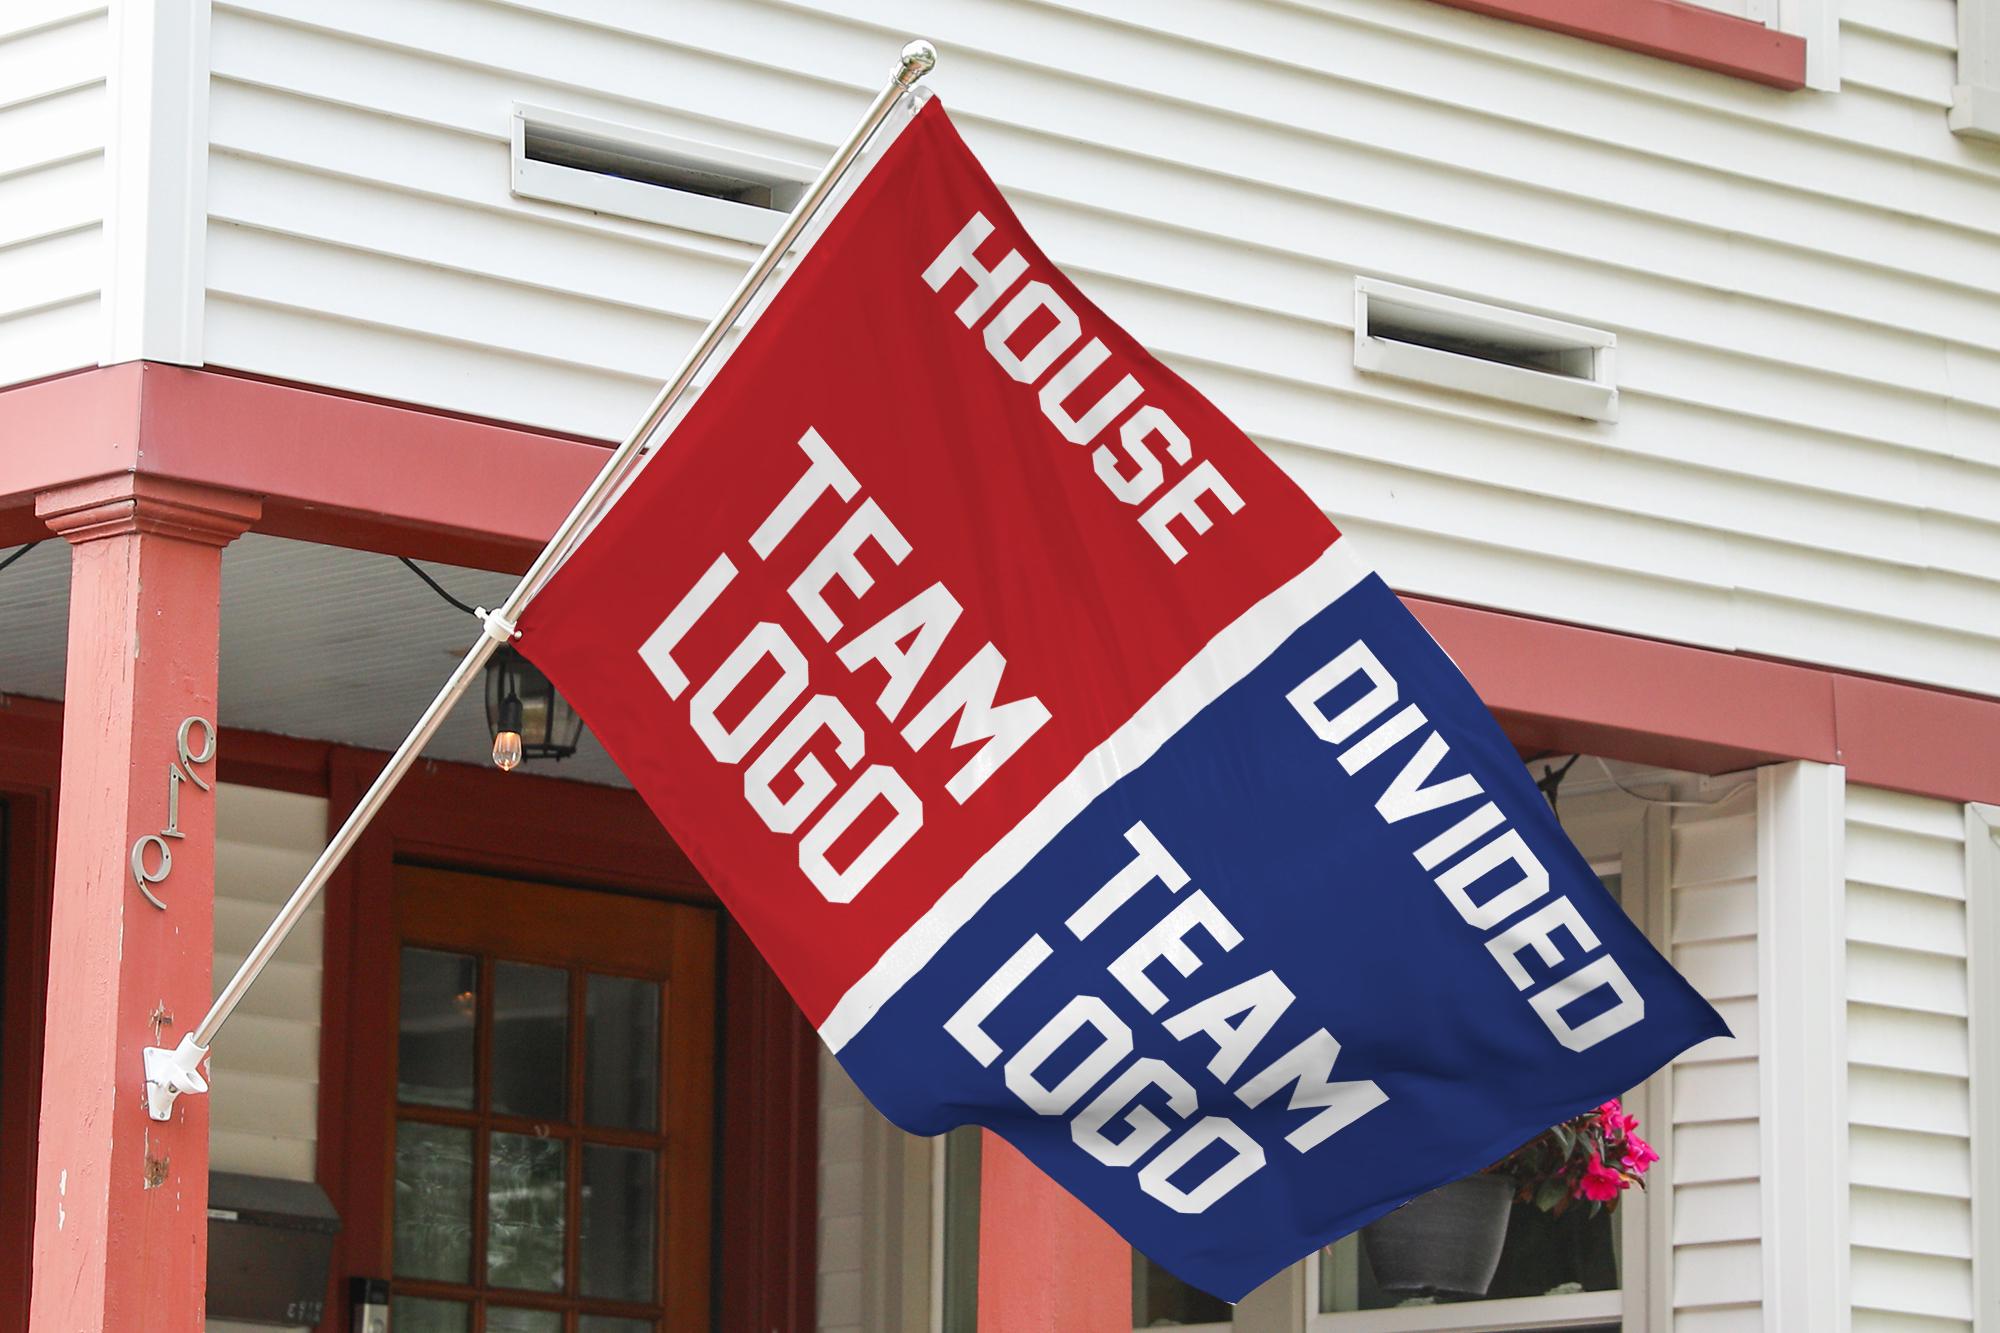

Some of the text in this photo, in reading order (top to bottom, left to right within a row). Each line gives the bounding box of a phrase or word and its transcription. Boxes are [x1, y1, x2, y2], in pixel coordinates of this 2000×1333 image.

[921, 211, 1246, 565] HOUSE
[638, 552, 924, 904] LOGO
[748, 426, 1053, 805] TEAM
[1064, 819, 1390, 1154] TEAM
[1284, 639, 1646, 1053] DIVIDED
[942, 932, 1267, 1214] LOGO
